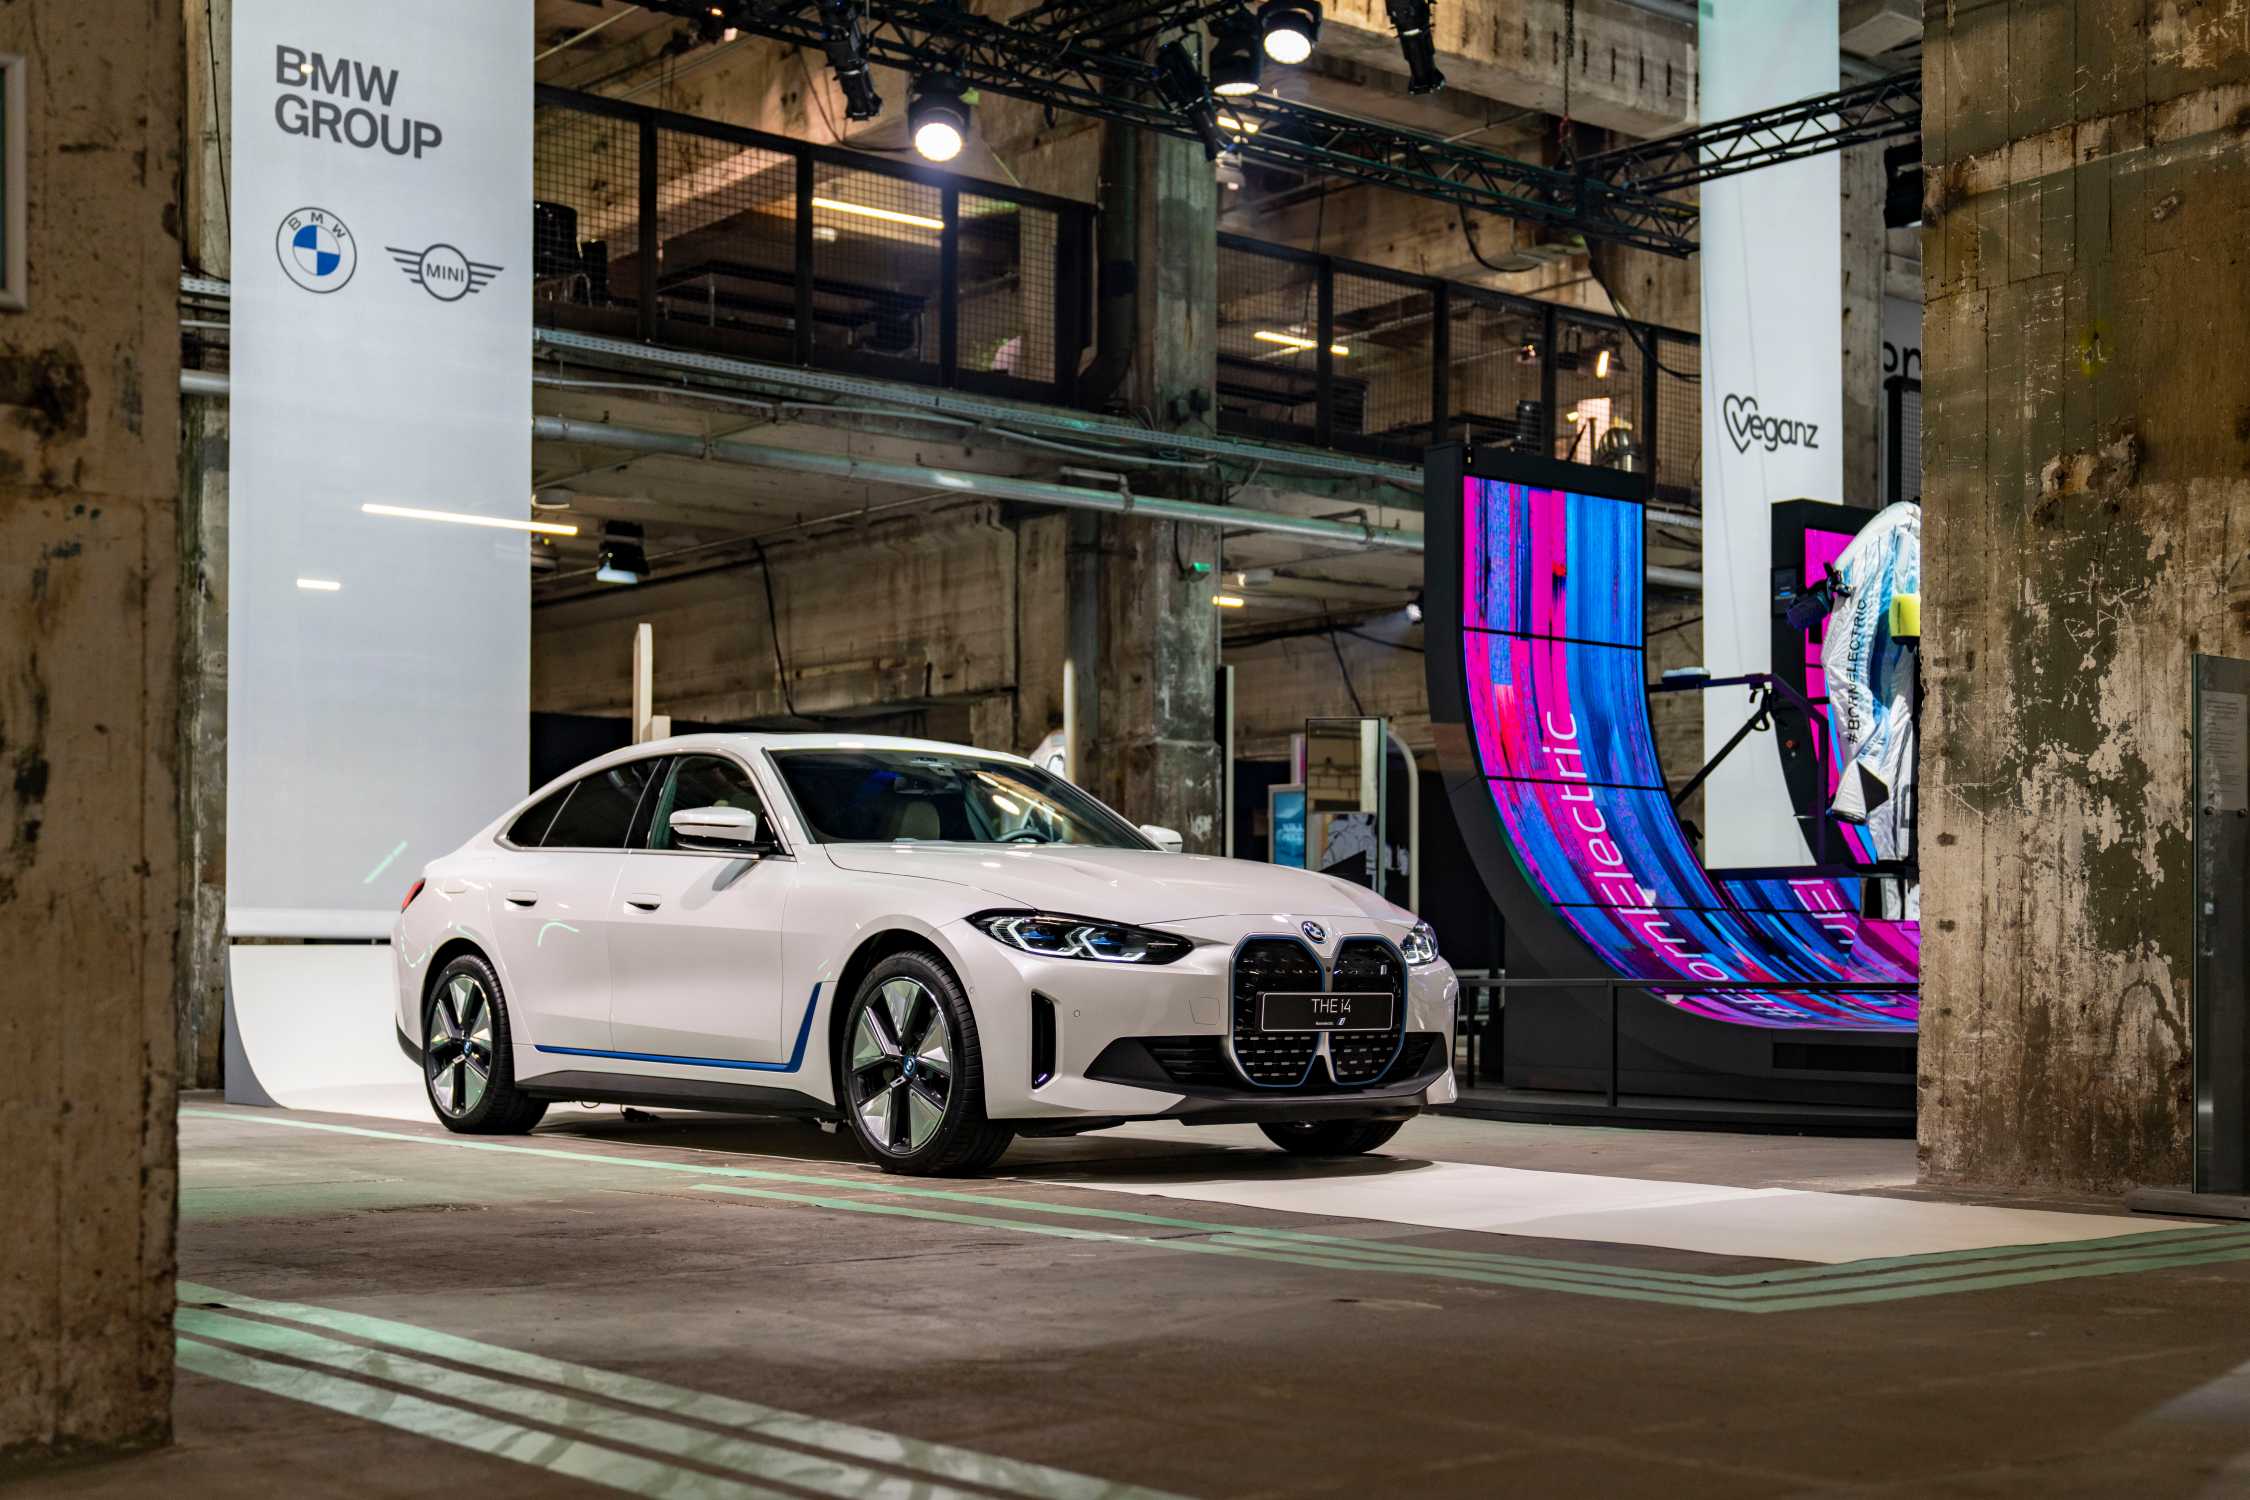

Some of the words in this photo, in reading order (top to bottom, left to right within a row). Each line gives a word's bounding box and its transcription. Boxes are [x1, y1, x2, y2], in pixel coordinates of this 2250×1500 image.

[276, 44, 399, 107] BMW
[275, 93, 442, 159] GROUP
[288, 211, 346, 239] BMW
[426, 263, 464, 282] MINI
[1311, 998, 1338, 1013] THE
[1341, 998, 1351, 1013] i4
